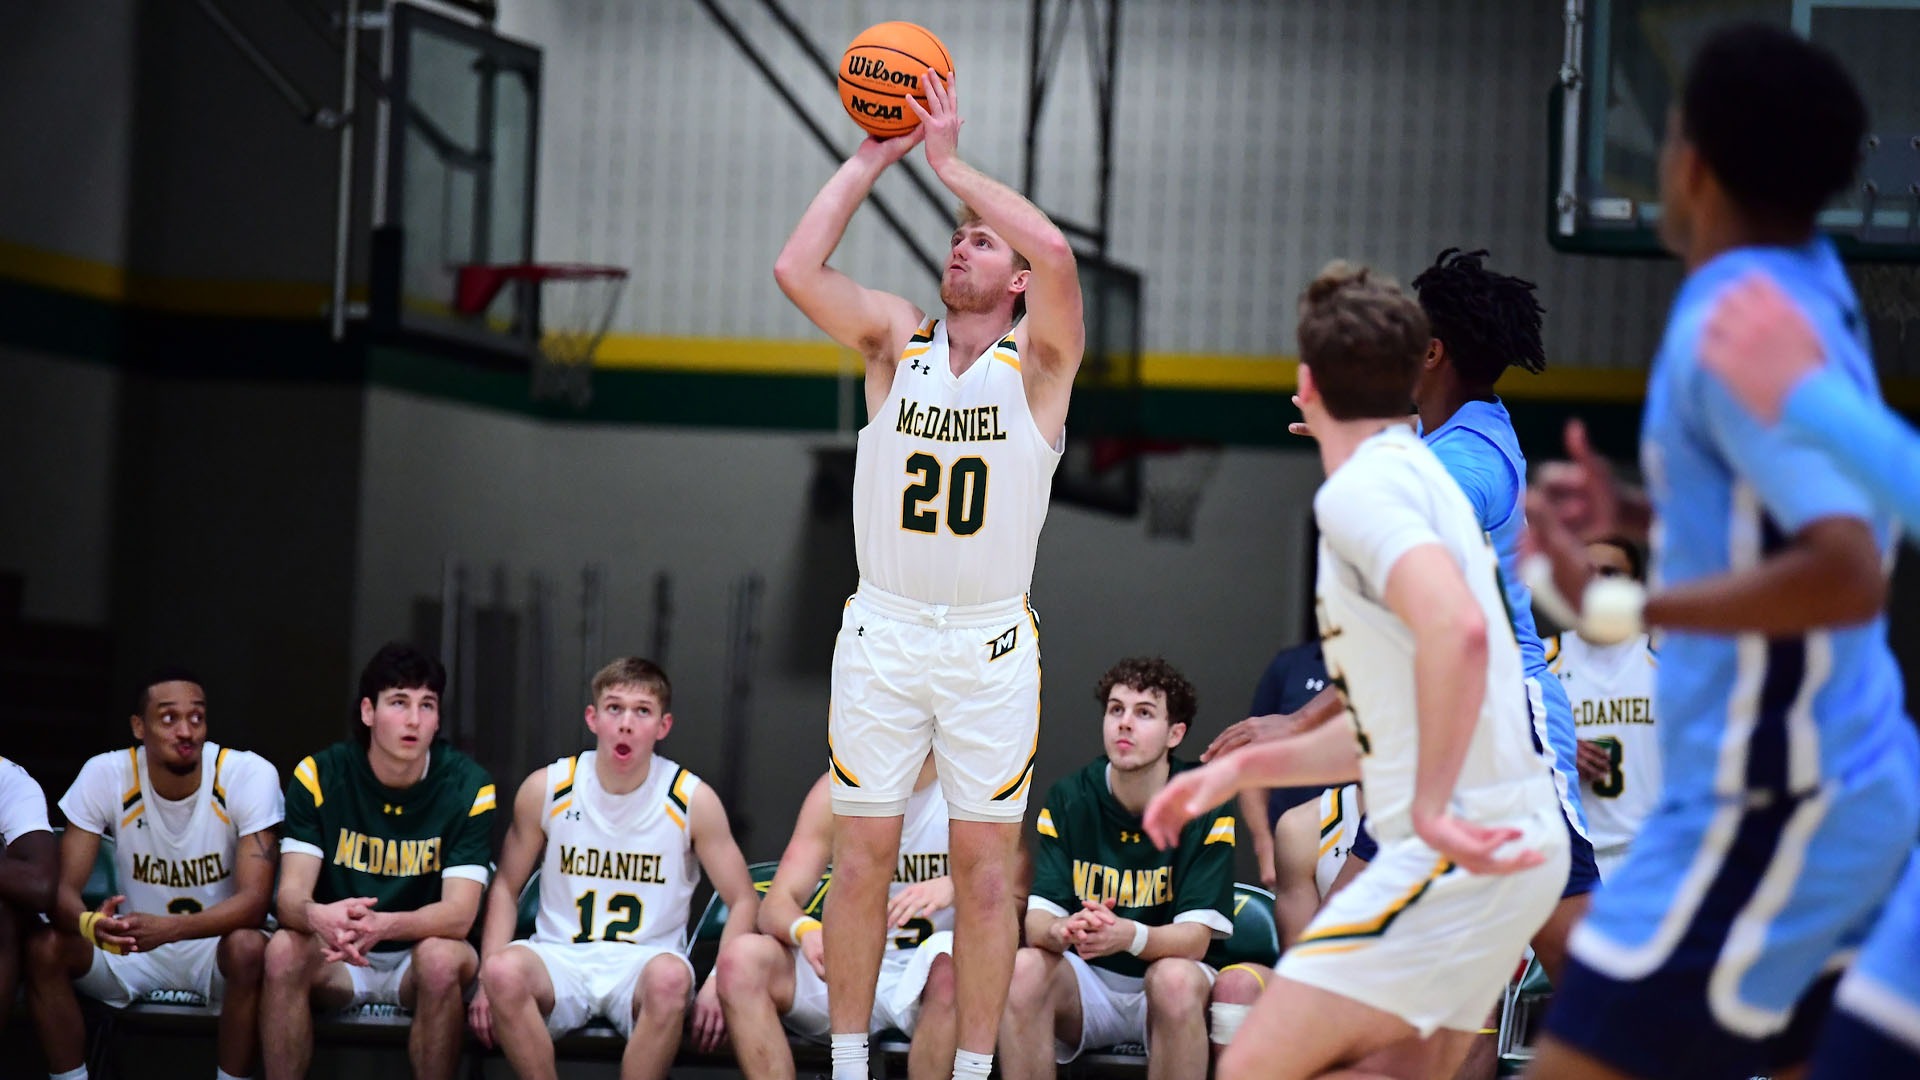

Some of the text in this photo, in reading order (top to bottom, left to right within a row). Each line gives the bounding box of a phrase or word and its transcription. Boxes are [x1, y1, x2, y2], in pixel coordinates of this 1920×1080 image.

[848, 55, 918, 90] Wilson
[851, 95, 903, 120] NCAA
[900, 450, 990, 538] 20
[1572, 697, 1655, 727] cDANIEL
[1591, 735, 1625, 799] 3
[571, 888, 644, 945] 12
